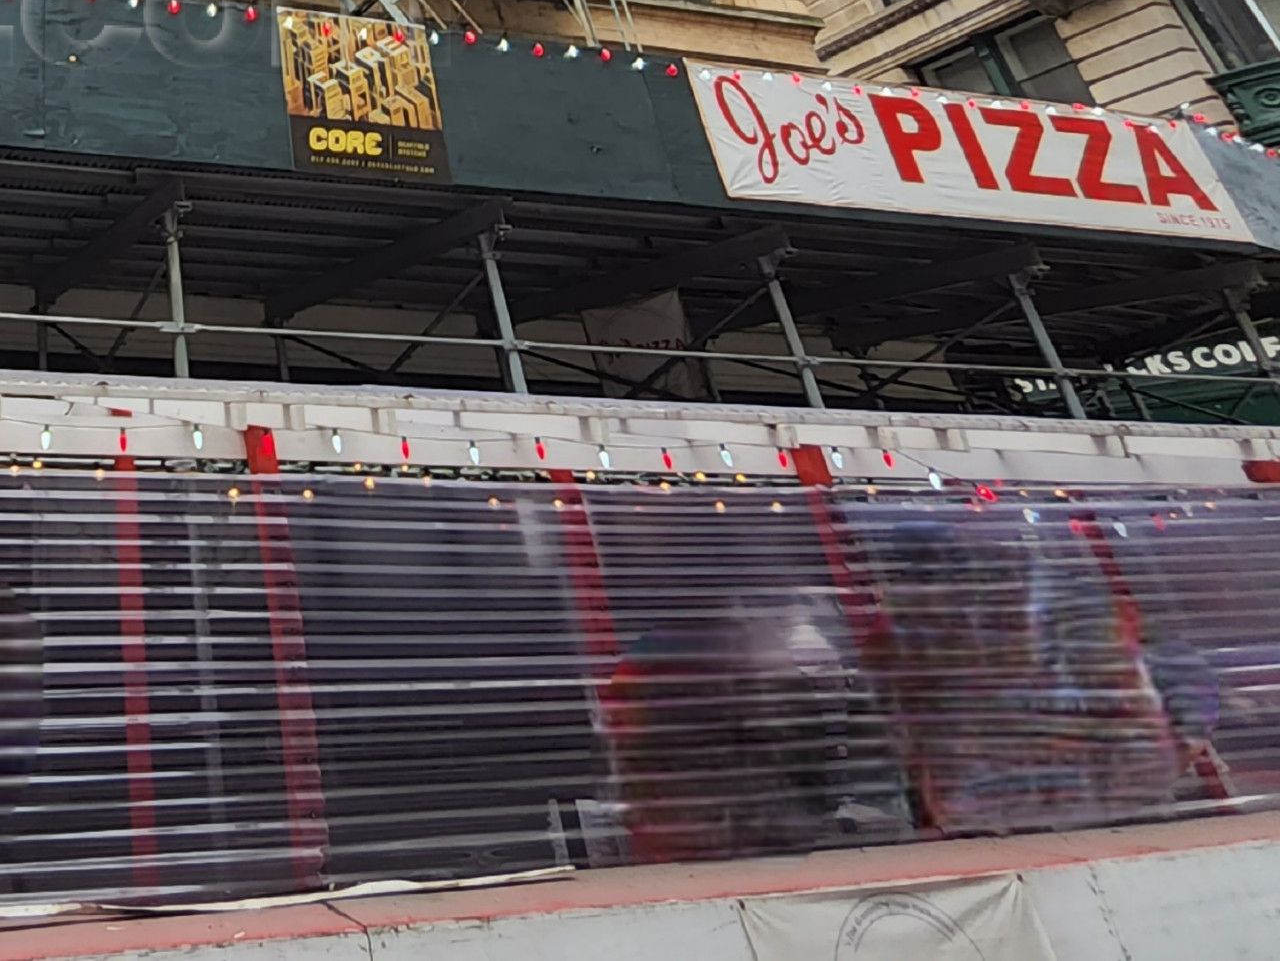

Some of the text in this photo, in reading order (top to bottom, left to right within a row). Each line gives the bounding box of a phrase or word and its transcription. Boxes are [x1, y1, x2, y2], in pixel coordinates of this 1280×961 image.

[309, 127, 382, 156] CORE
[713, 74, 1219, 212] Joe's PIZZA
[1156, 212, 1201, 227] SINCE
